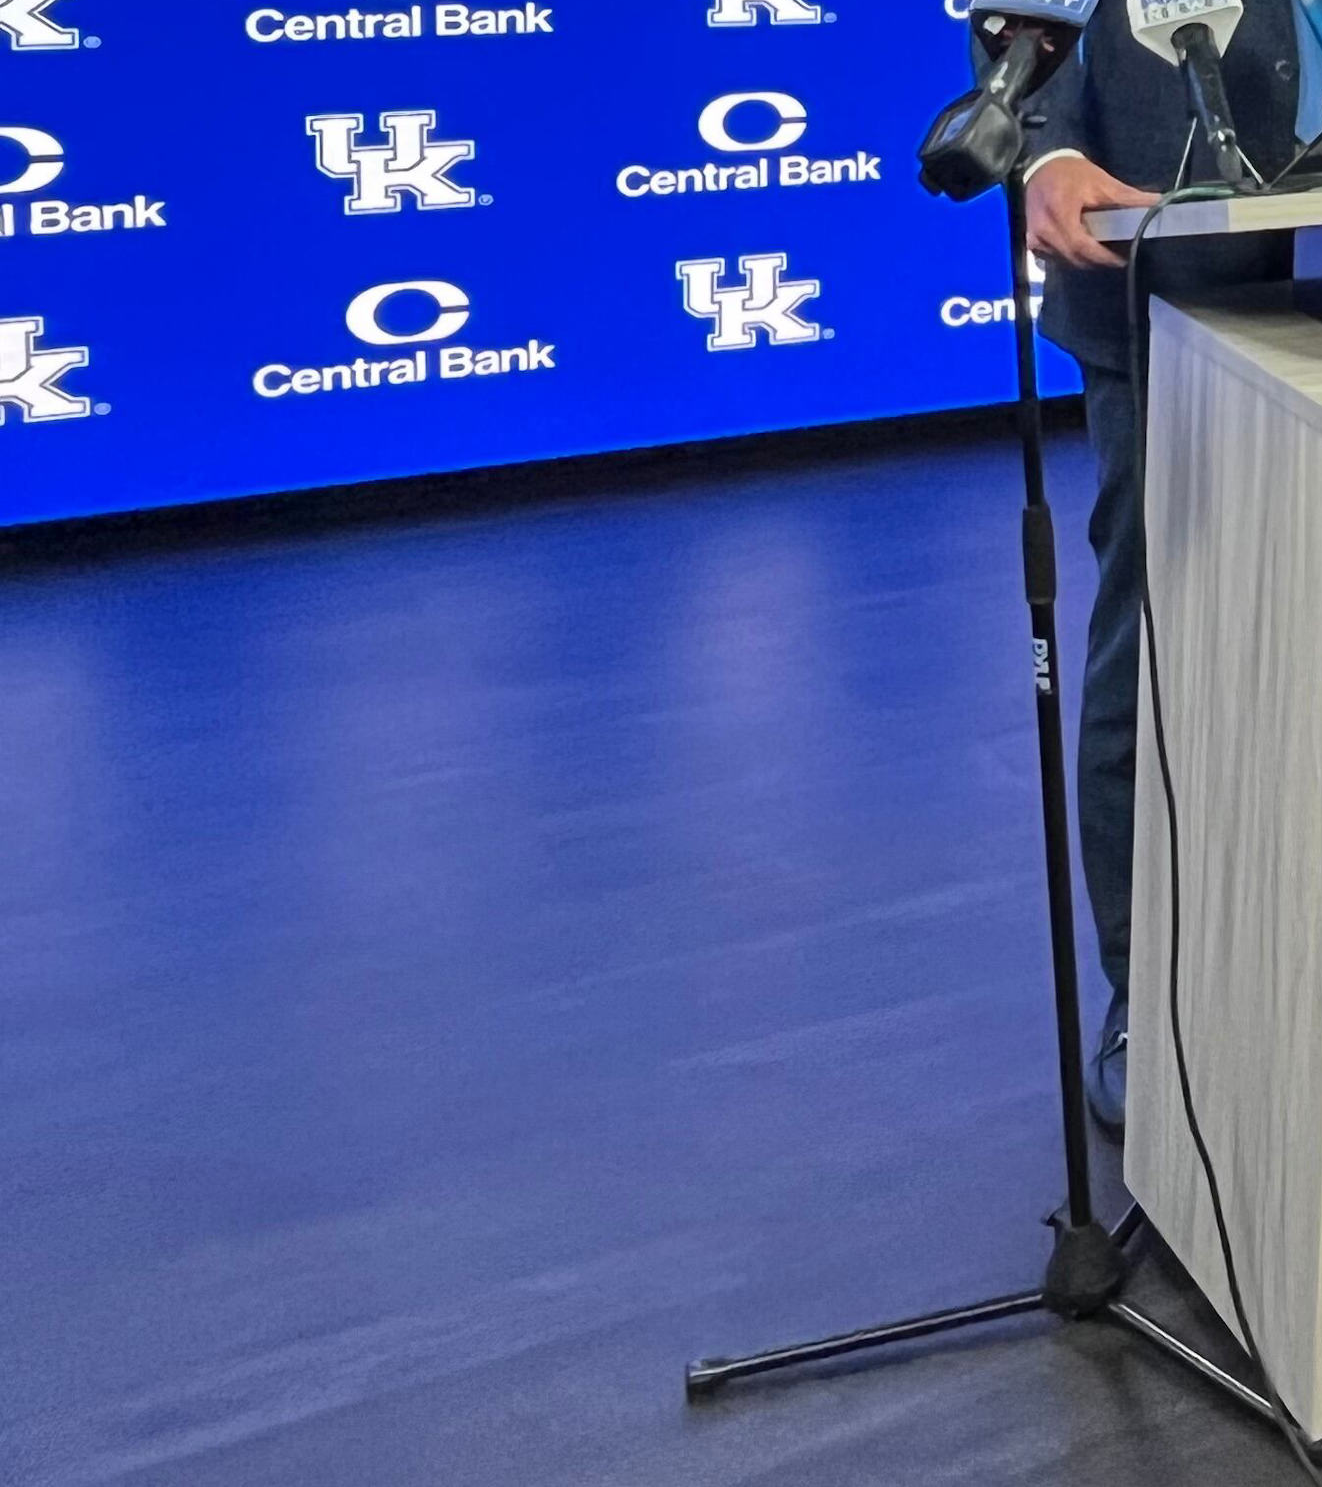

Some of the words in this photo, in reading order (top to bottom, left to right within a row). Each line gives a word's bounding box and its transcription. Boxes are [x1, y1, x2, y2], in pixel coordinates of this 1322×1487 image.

[245, 4, 422, 43] Central
[435, 1, 554, 37] Bank
[616, 157, 769, 198] Central
[778, 150, 881, 187] Bank
[29, 194, 167, 235] Bank
[252, 350, 427, 398] Central
[439, 339, 556, 379] Bank
